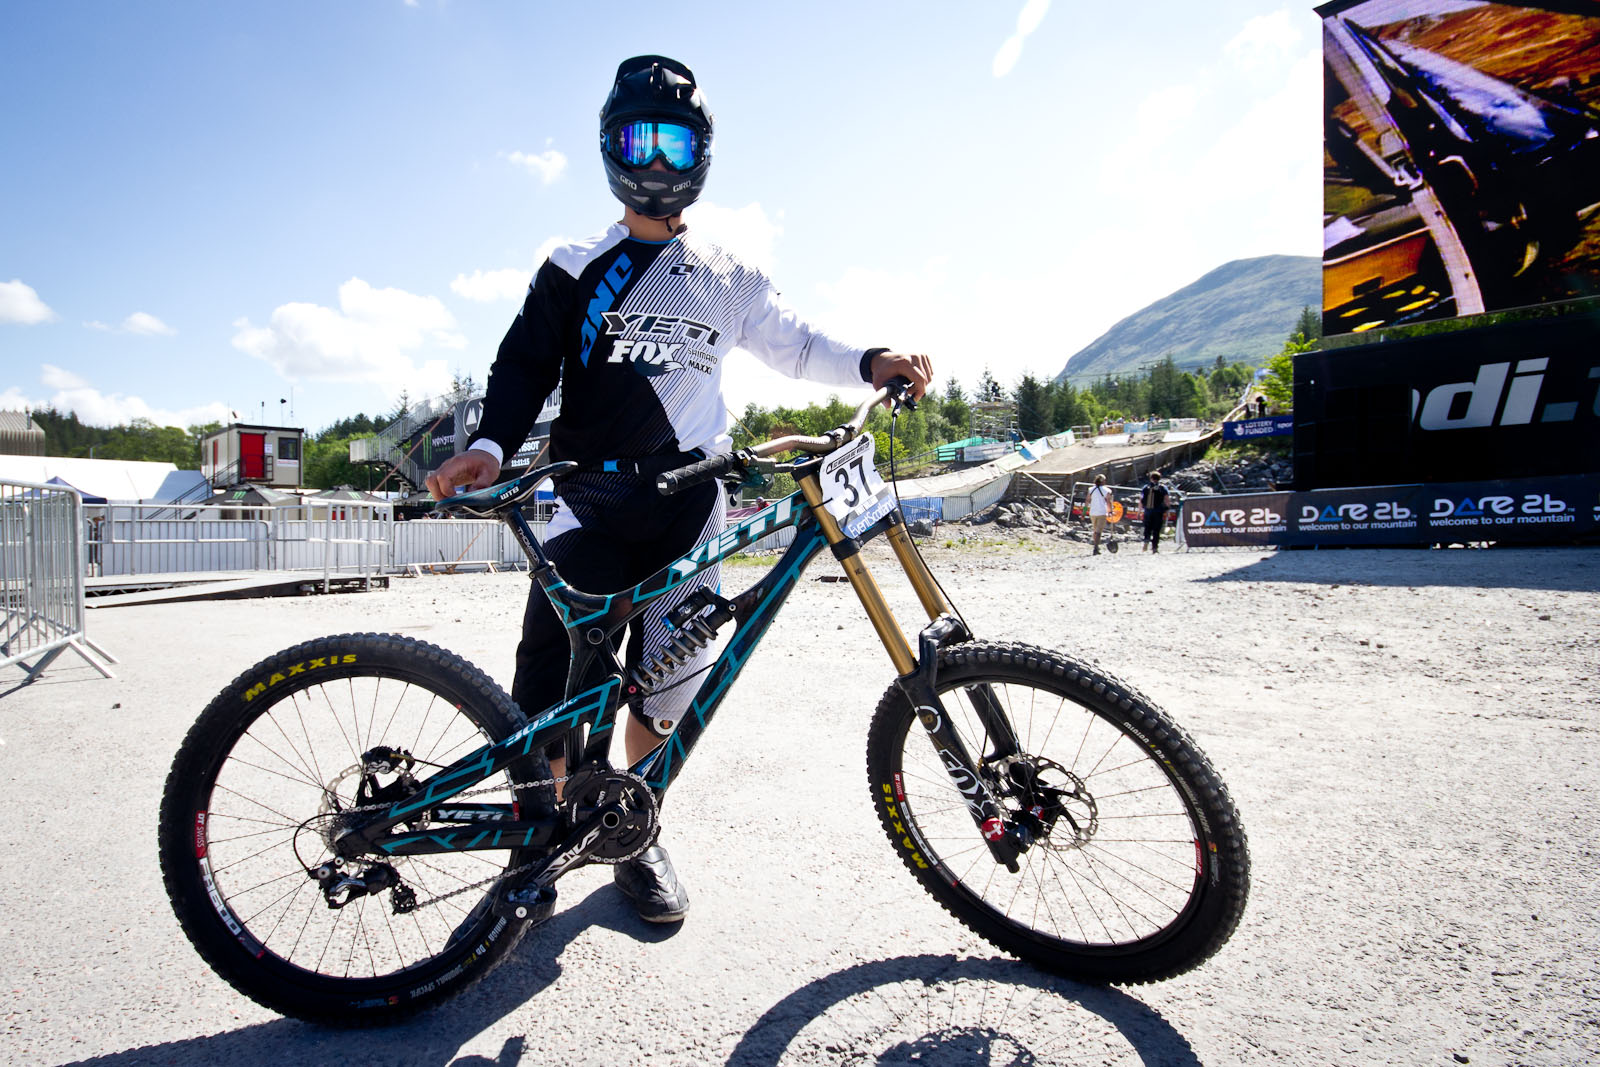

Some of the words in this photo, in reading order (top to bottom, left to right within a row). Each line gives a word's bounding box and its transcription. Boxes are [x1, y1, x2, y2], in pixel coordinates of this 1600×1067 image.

[620, 174, 637, 191] GIRO
[673, 180, 692, 192] GIRO
[600, 312, 721, 347] YETI
[607, 340, 686, 365] FOX
[1245, 427, 1274, 435] FUNDED
[518, 441, 540, 452] ISSOT
[835, 456, 873, 508] 37
[500, 486, 520, 500] WTB
[1299, 523, 1339, 531] welcome
[1341, 522, 1351, 530] to
[1352, 522, 1369, 530] our
[1371, 520, 1417, 529] mountain
[1429, 517, 1478, 526] welcome
[1481, 516, 1493, 525] to
[1495, 516, 1515, 525] our
[1517, 513, 1575, 524] mountain
[1187, 526, 1222, 535] welcome
[1247, 524, 1287, 533] mountain
[670, 497, 793, 580] YETI
[243, 654, 358, 701] MAXXIS
[938, 748, 995, 819] FOX
[197, 812, 206, 824] DT
[437, 809, 504, 821] YETI
[882, 783, 929, 869] MAXXIS
[196, 826, 205, 848] SWISS
